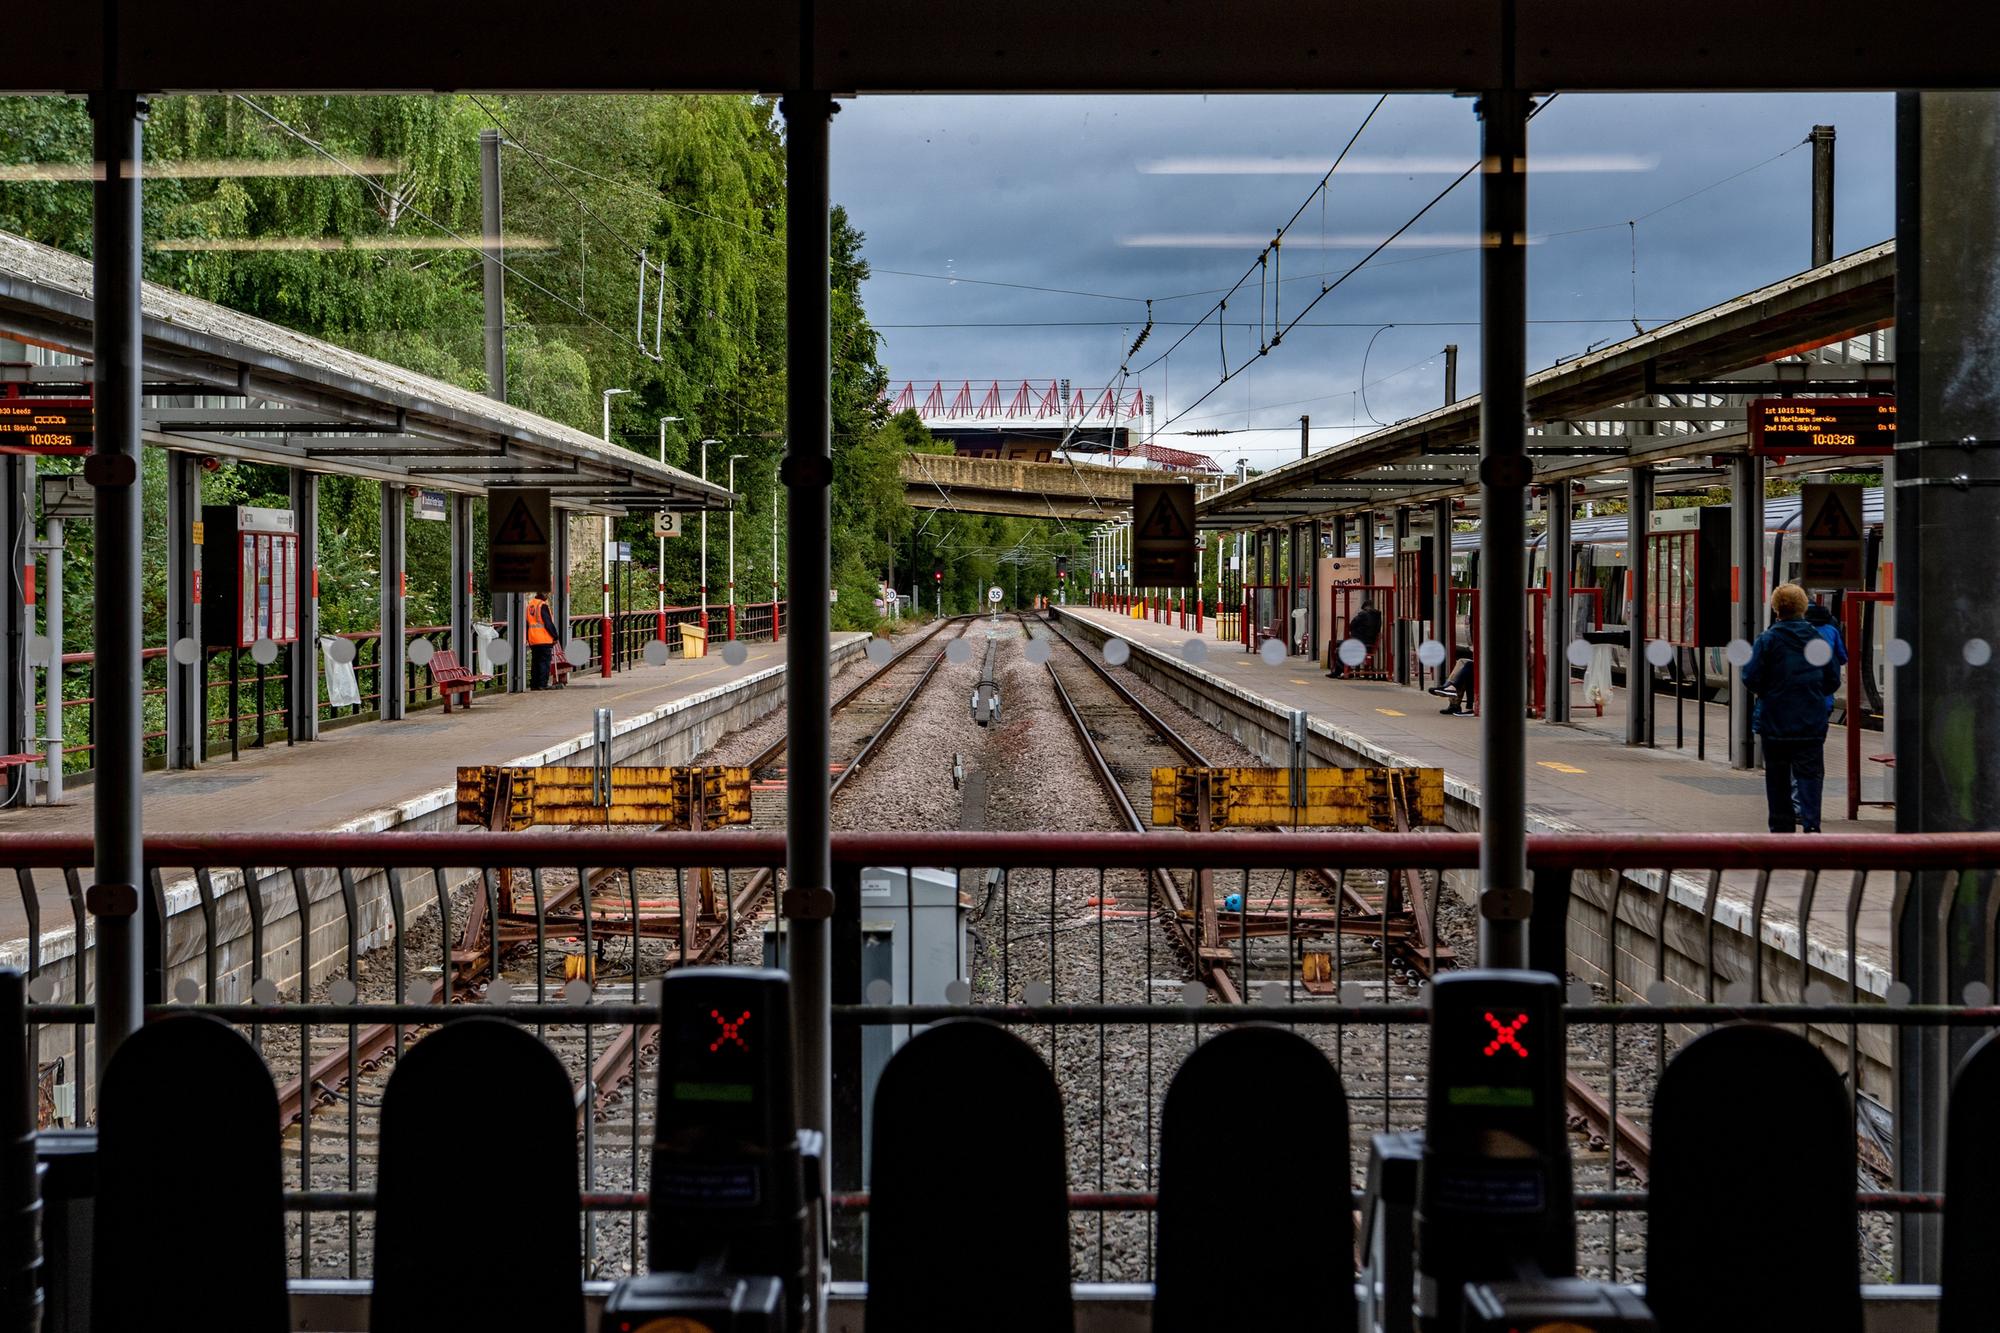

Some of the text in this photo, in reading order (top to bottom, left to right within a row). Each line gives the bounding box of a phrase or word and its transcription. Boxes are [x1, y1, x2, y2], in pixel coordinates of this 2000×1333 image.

[1796, 424, 1821, 432] Skipton
[30, 434, 72, 445] 10:03:25
[1812, 434, 1855, 445] 10:03:26
[660, 514, 673, 531] 3
[1333, 578, 1352, 586] Check
[990, 590, 1001, 599] 35
